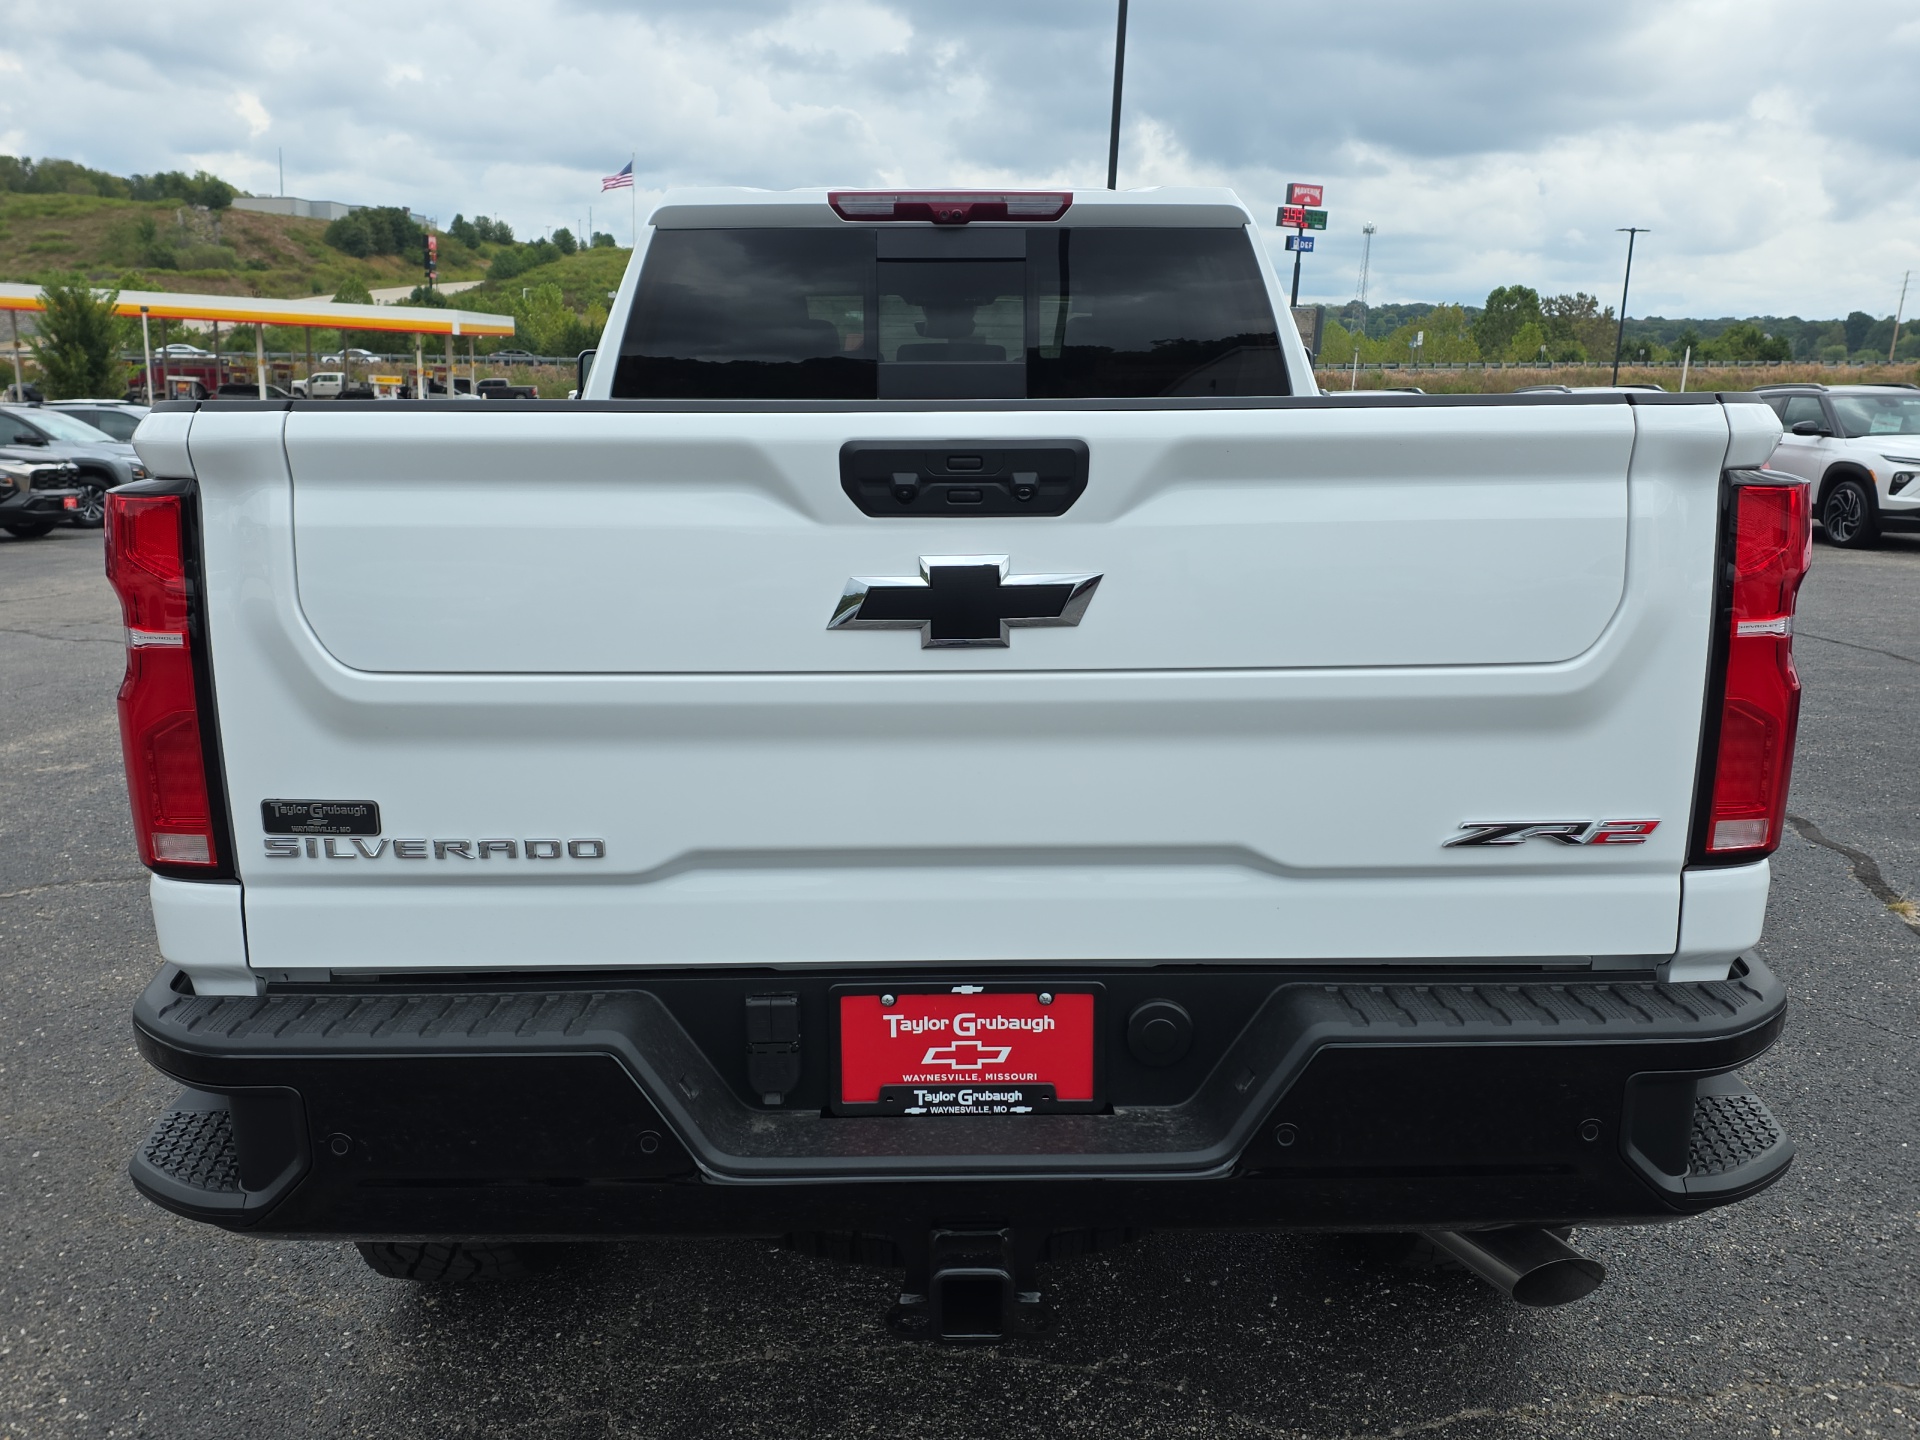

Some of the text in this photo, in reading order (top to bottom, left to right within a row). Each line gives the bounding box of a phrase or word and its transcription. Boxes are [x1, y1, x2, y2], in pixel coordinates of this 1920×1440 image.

[1300, 241, 1313, 249] DEF
[270, 802, 367, 818] Taylor Grubaugh
[1441, 818, 1662, 848] ZR2
[263, 837, 606, 859] SILVERADO
[882, 1012, 1055, 1038] Taylor Grubaugh
[902, 1072, 1038, 1082] WAYNESVILLE, MISSOURI
[913, 1089, 1023, 1106] Taylor Grubaugh
[929, 1105, 1008, 1114] WAYNESVILLE, MO
